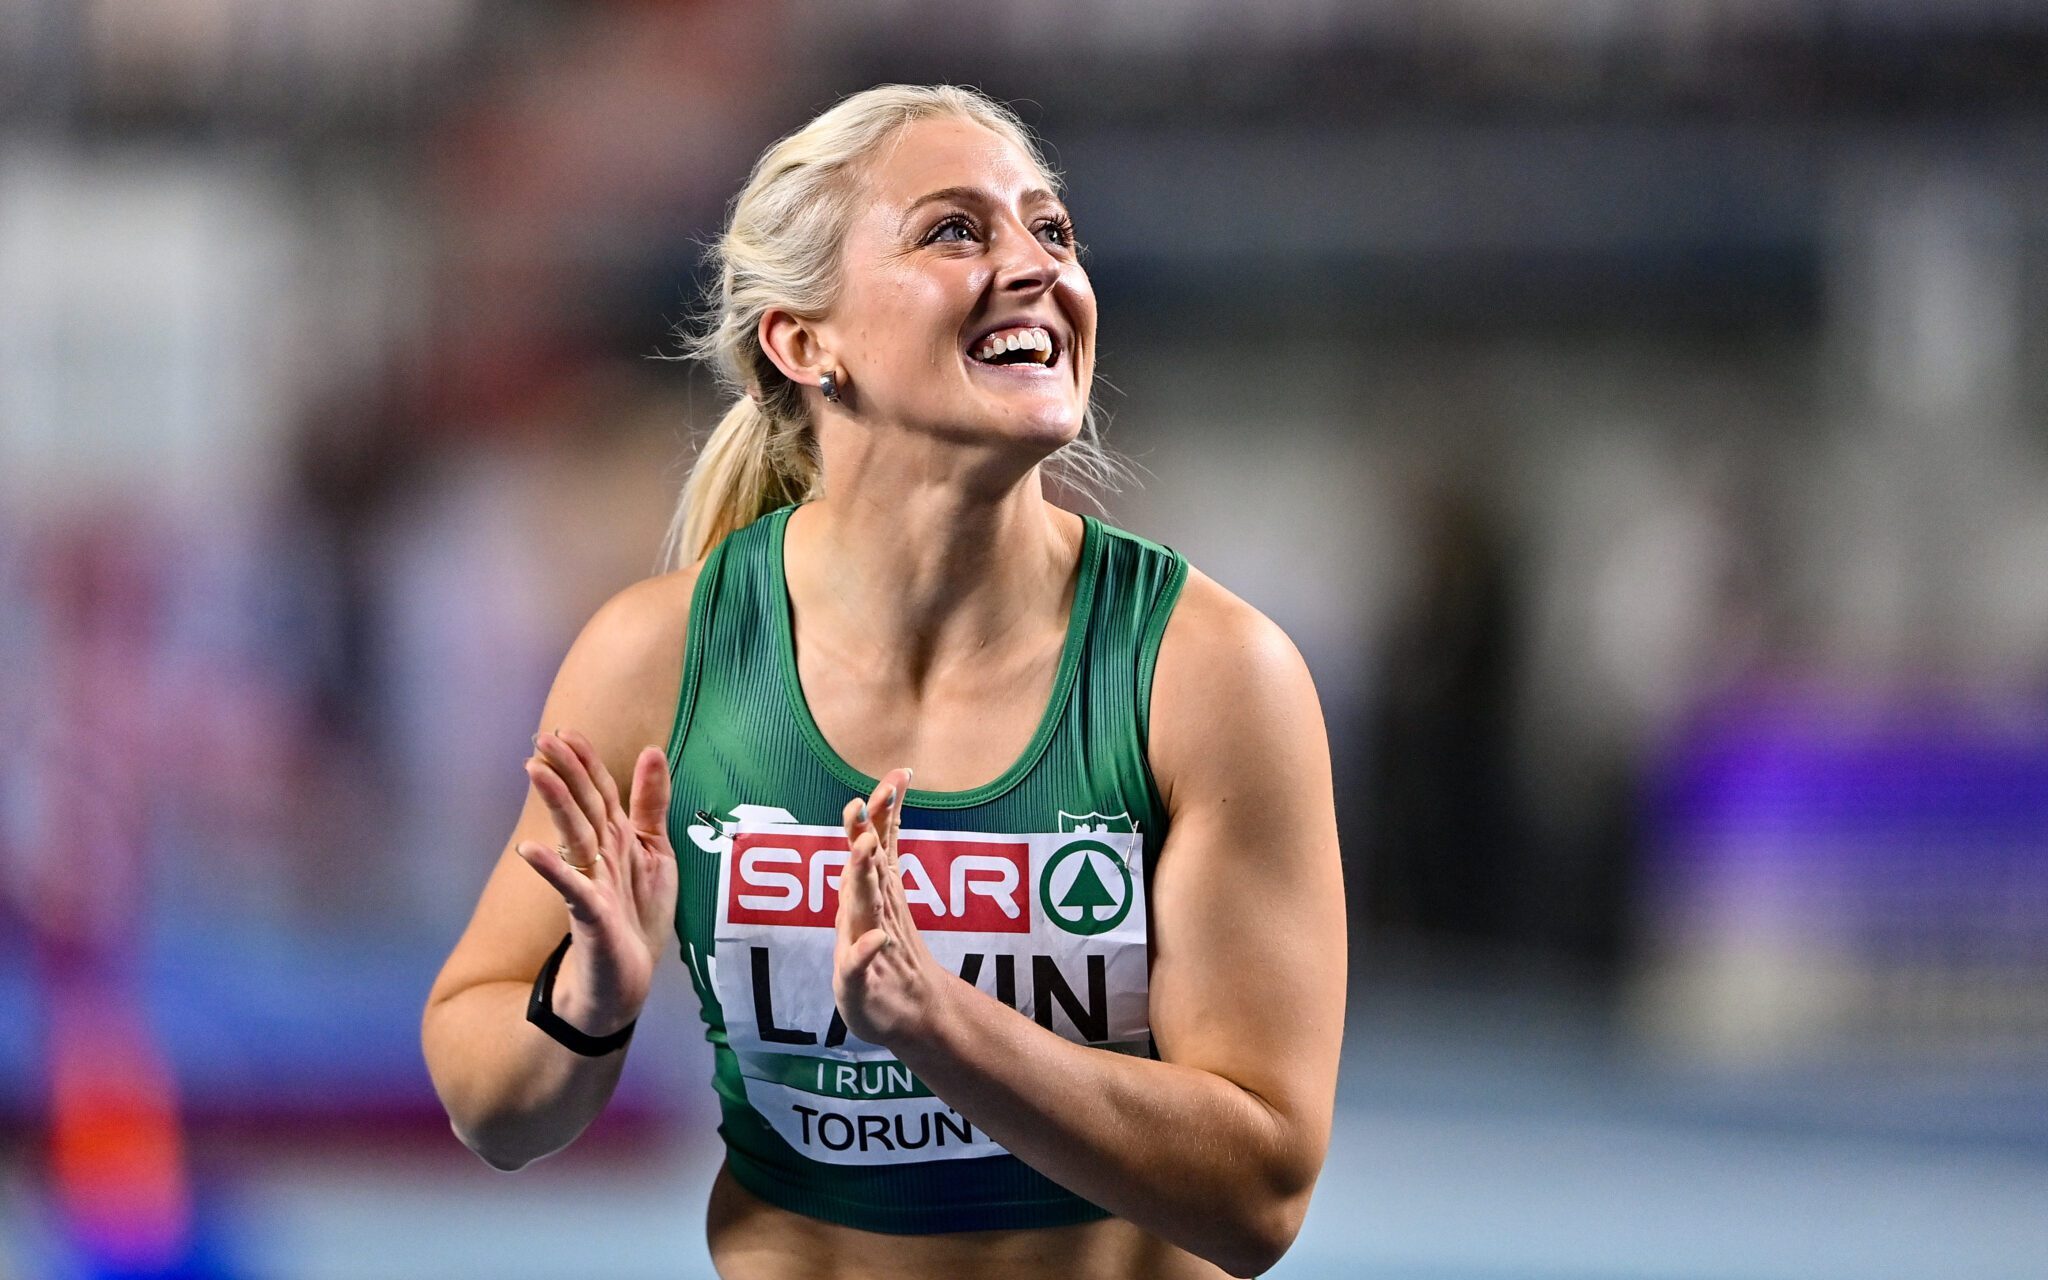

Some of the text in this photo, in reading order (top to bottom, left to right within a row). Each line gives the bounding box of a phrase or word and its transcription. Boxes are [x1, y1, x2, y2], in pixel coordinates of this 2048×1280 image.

[750, 946, 1109, 1048] LIN
[816, 1062, 914, 1094] I RUN
